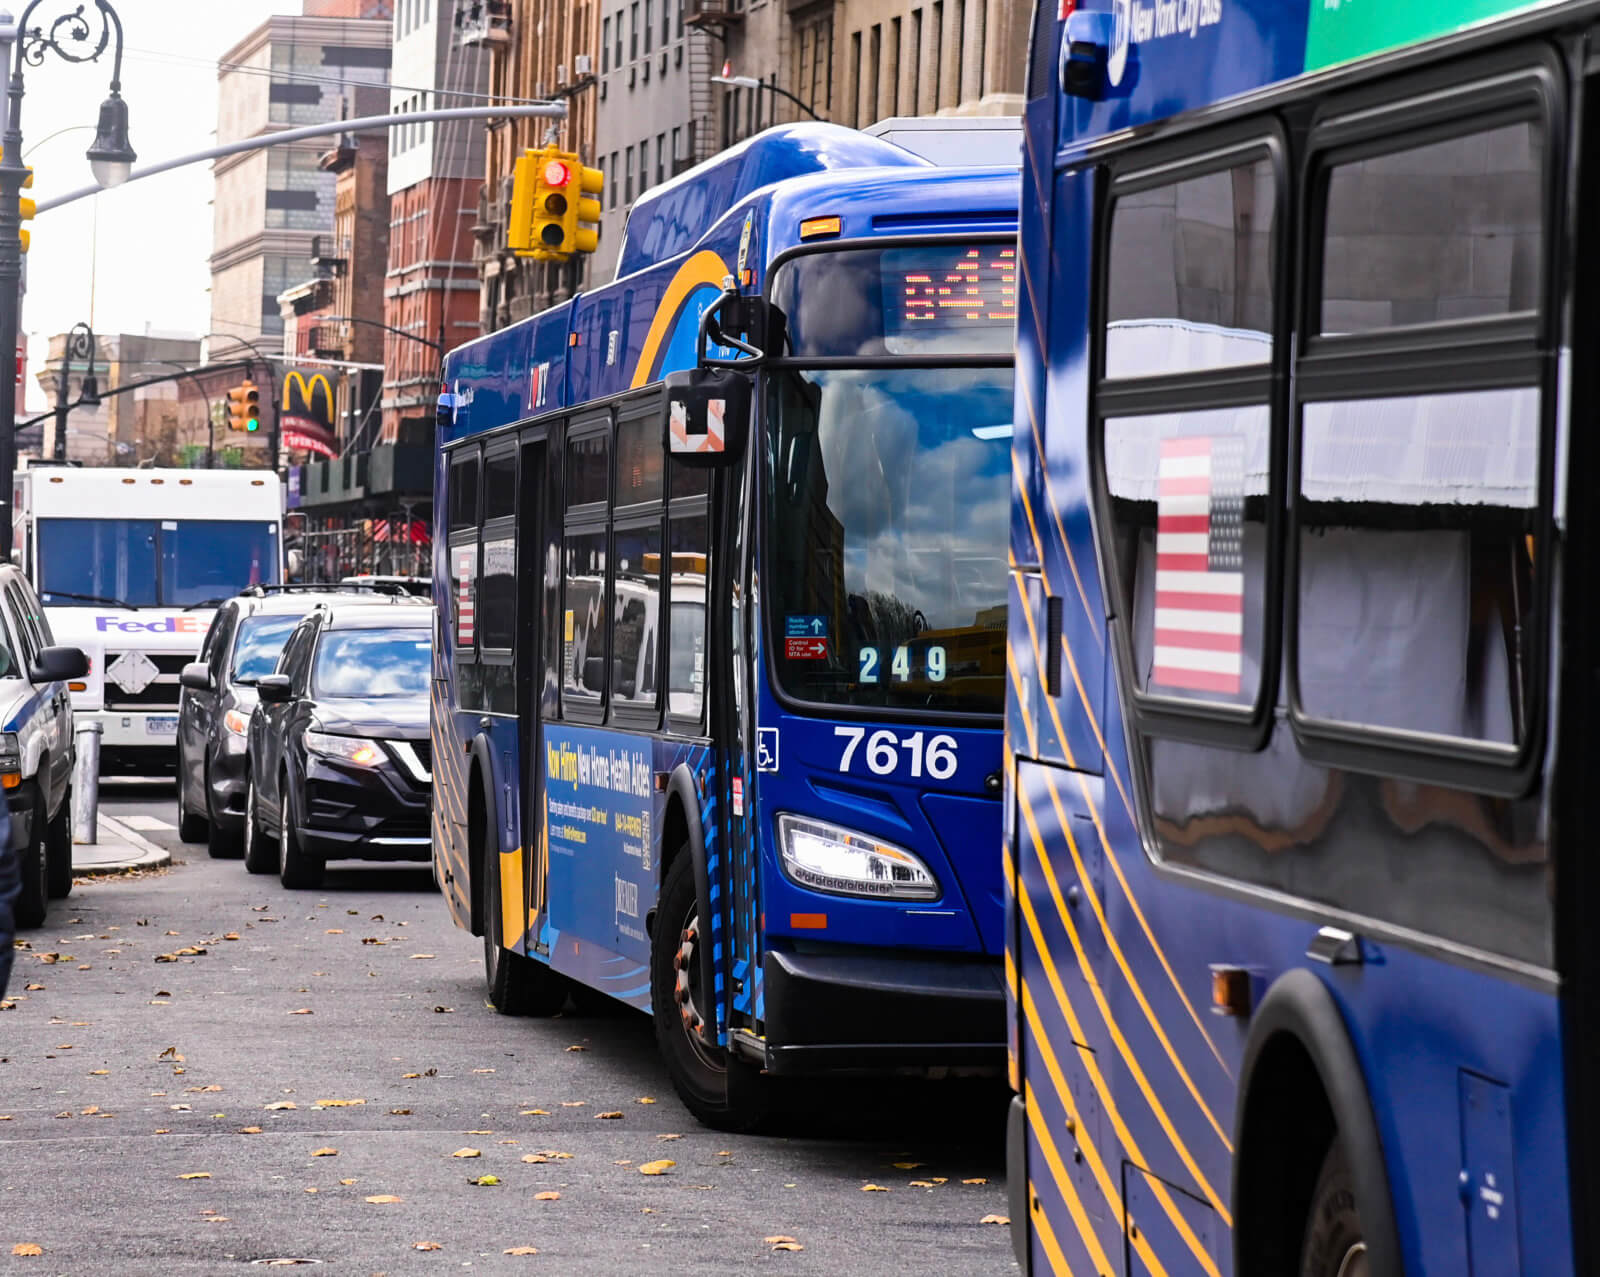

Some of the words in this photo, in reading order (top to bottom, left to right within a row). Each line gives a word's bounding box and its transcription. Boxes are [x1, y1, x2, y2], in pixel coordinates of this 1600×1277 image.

[1132, 0, 1154, 43] New
[1155, 0, 1178, 38] York
[547, 740, 560, 779] Now
[560, 741, 577, 791] Hiring
[577, 743, 591, 785] New
[591, 745, 609, 790] Home
[610, 749, 631, 794] Health
[632, 752, 650, 799] Aides
[833, 726, 959, 780] 7616
